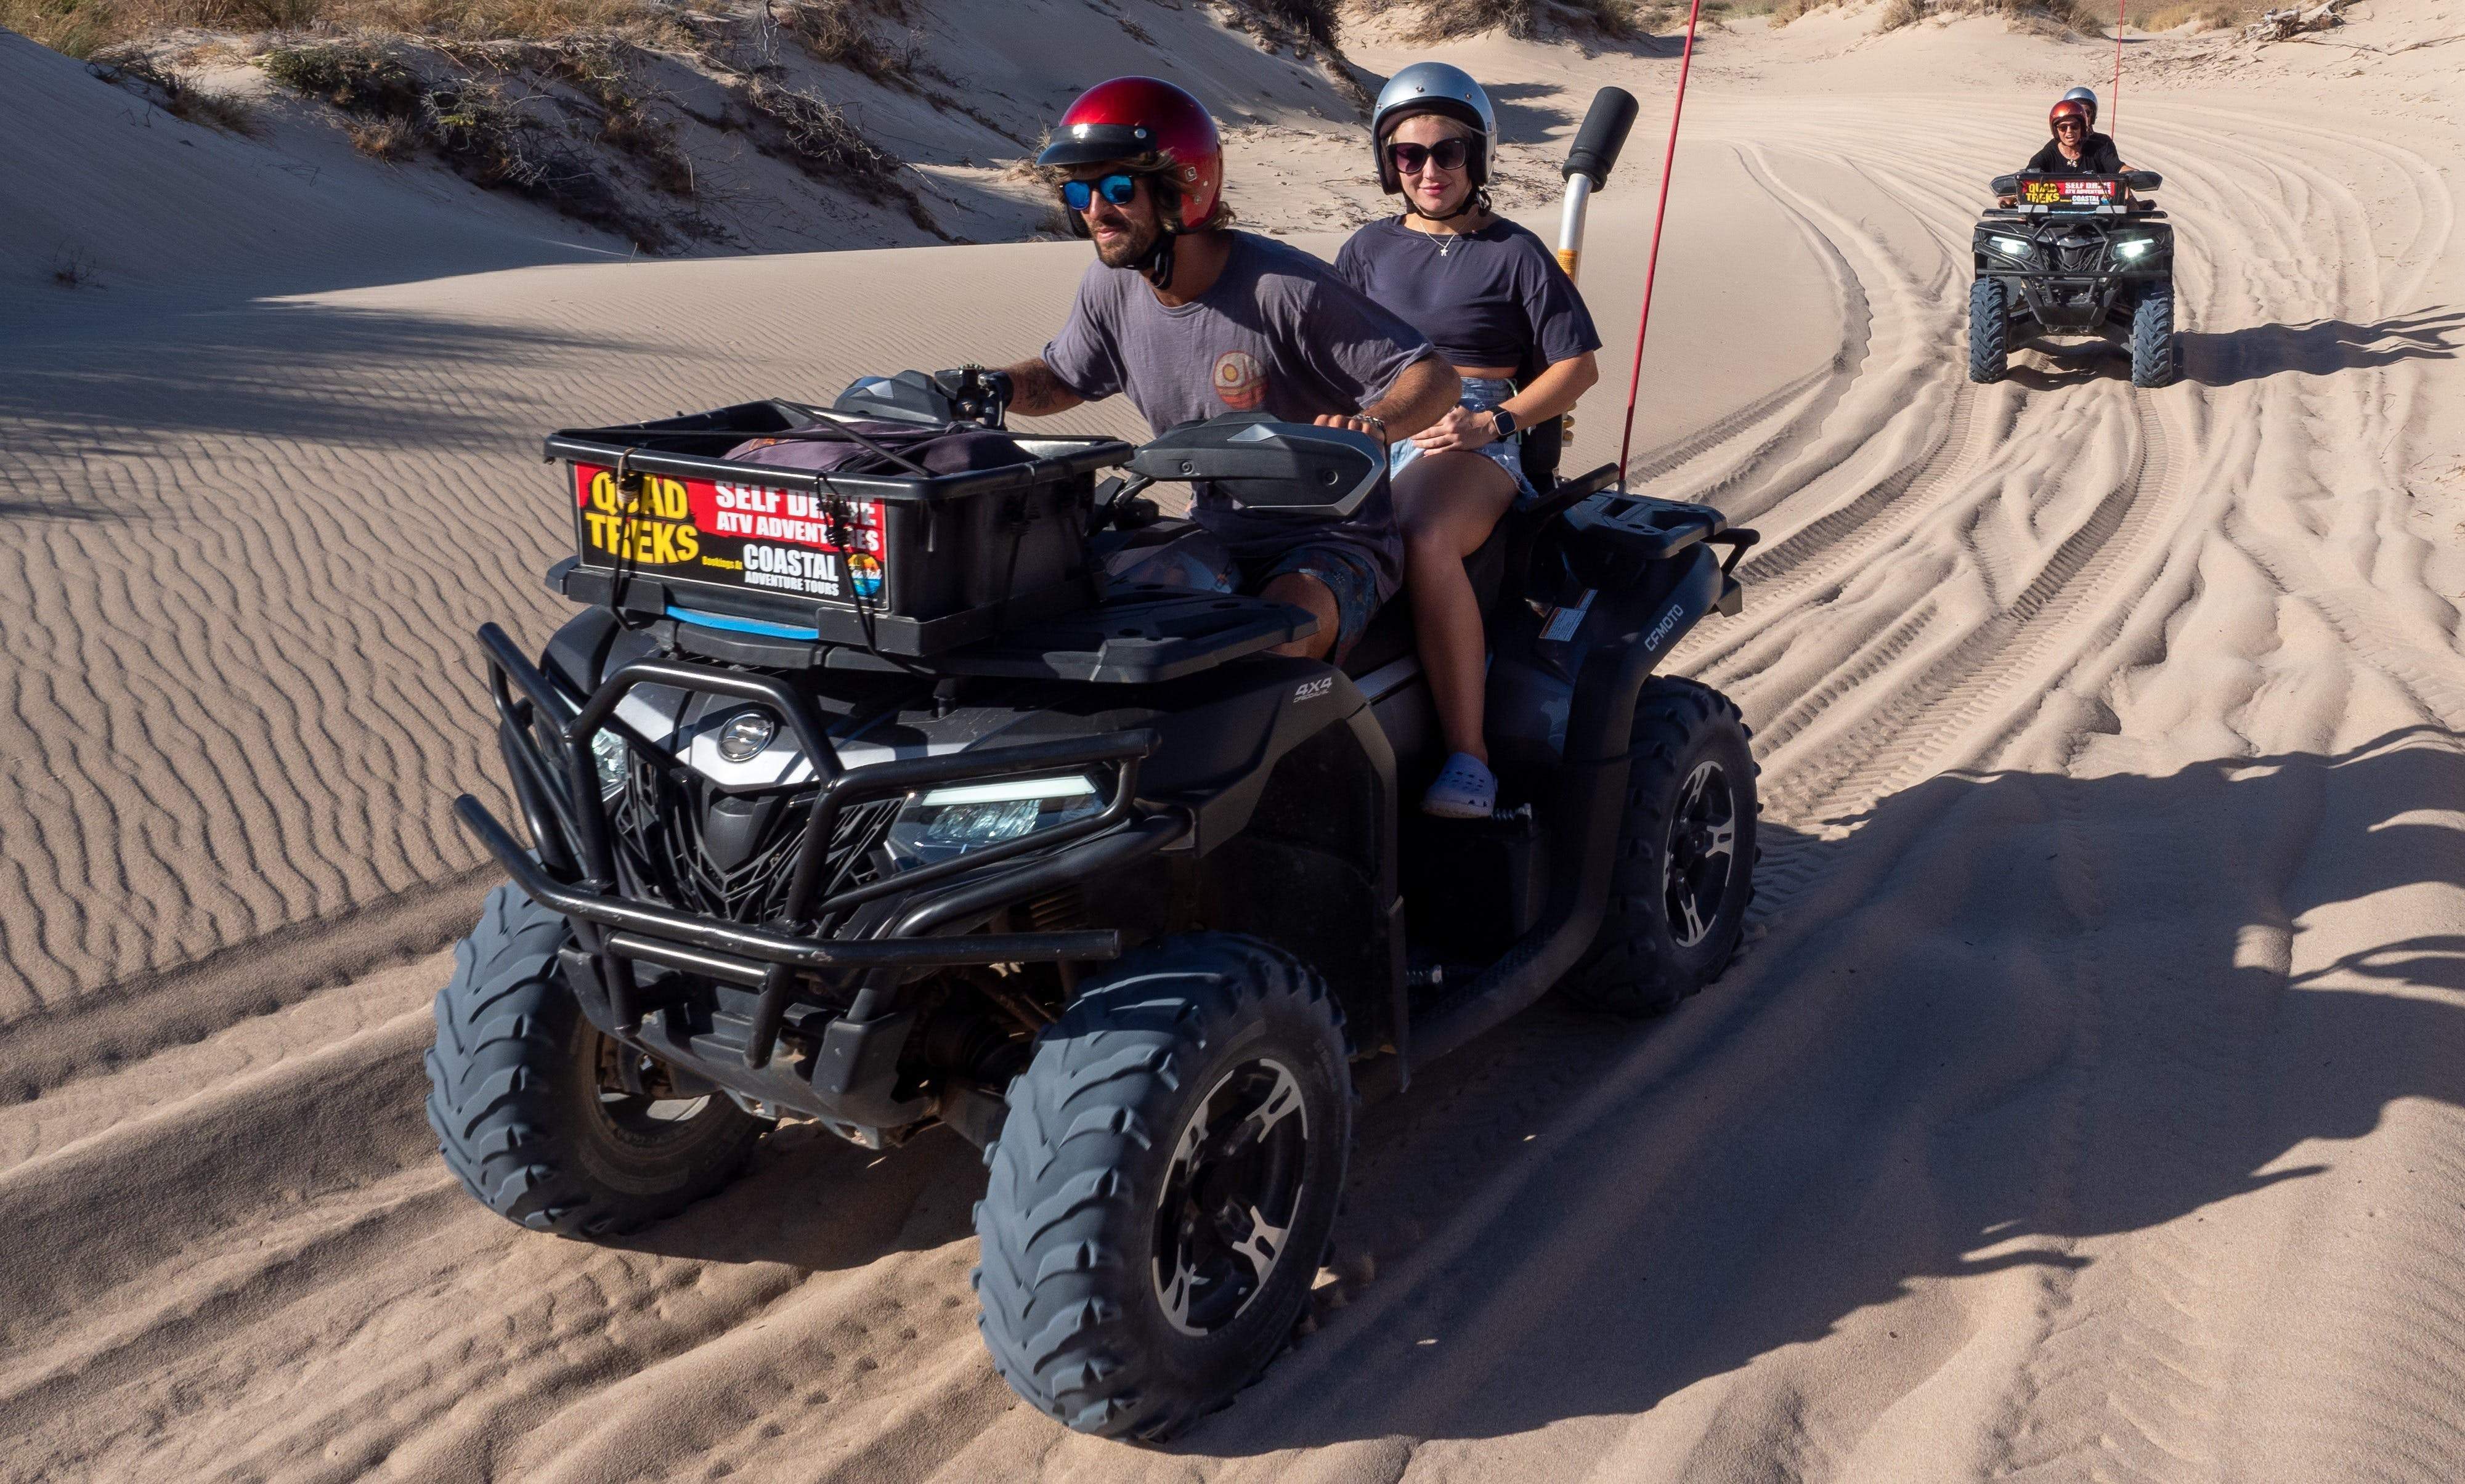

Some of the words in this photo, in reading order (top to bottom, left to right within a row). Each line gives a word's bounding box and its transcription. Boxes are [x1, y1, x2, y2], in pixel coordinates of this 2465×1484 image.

[2026, 192, 2060, 203] TREKS
[715, 480, 781, 514] SELF
[787, 489, 877, 527] DRVE
[585, 512, 700, 564] TREKS
[716, 511, 753, 534] ATV
[755, 516, 880, 551] ADVENTRES
[742, 543, 840, 582] COASTAL
[744, 570, 804, 591] ADVENTURE
[804, 579, 840, 596] TOURS
[1644, 604, 1684, 651] CFMOTO
